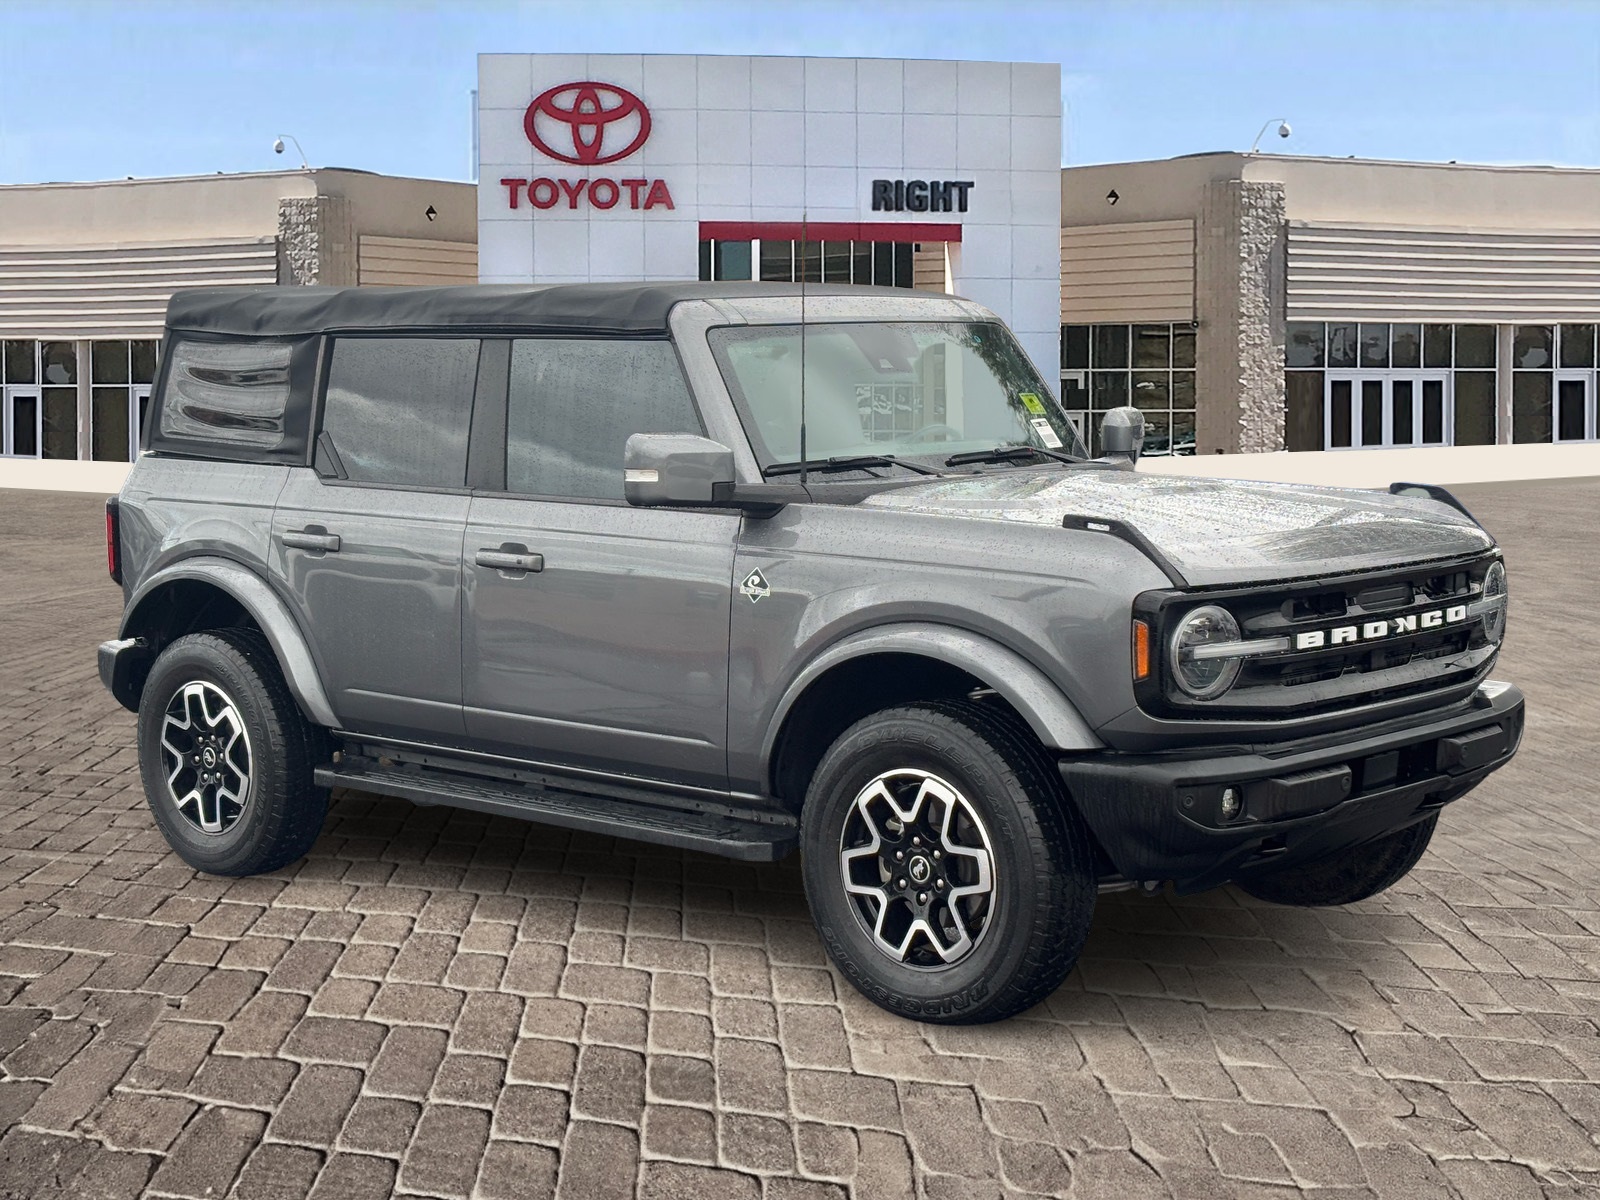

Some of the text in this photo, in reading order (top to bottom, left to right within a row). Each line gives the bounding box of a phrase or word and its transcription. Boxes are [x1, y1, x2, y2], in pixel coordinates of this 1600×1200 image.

[501, 178, 675, 210] TOYOTA
[872, 179, 975, 212] RIGHT
[1296, 604, 1467, 650] BRONCO
[857, 727, 987, 787] DUELER
[821, 925, 990, 1015] BRIDGESTONE
